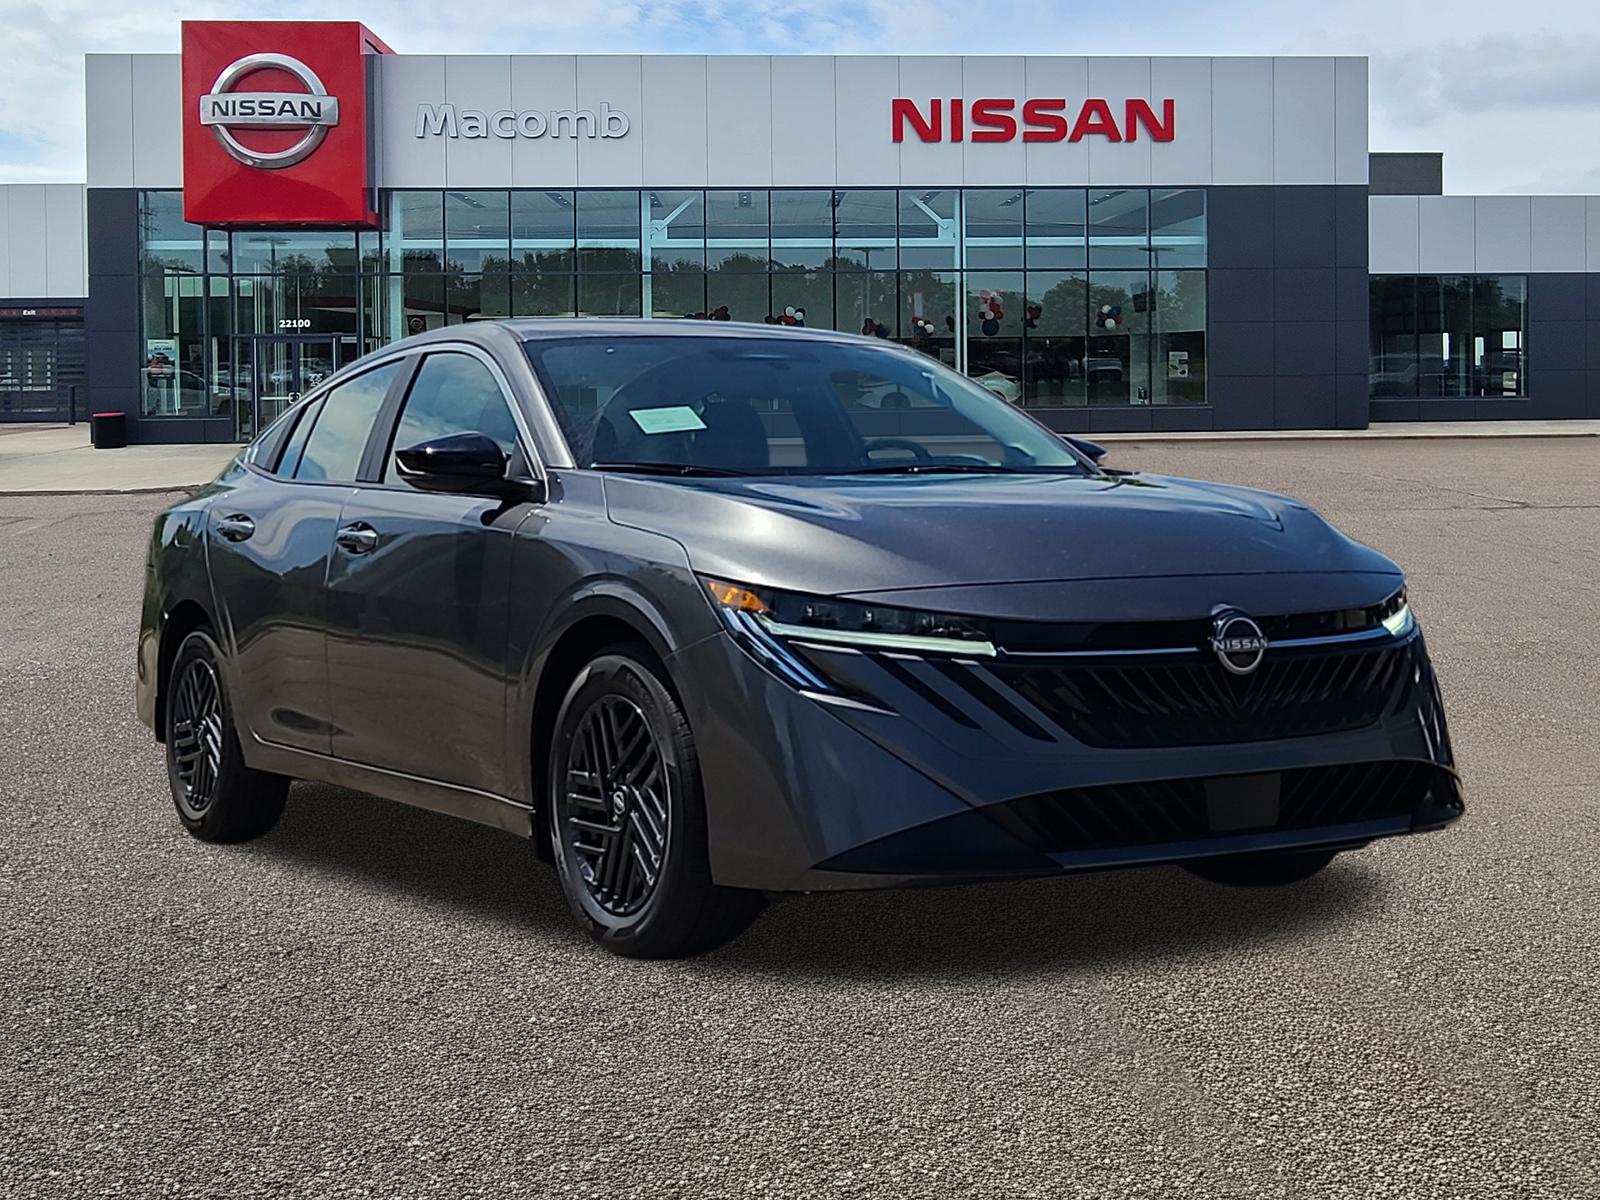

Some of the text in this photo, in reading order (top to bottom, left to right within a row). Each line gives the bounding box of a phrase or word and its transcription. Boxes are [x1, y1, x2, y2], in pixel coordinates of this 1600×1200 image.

[211, 98, 322, 118] NISSAN
[415, 102, 630, 139] Macomb
[892, 98, 1175, 142] NISSAN
[279, 319, 311, 328] 22100
[1213, 638, 1268, 651] NISSAN
